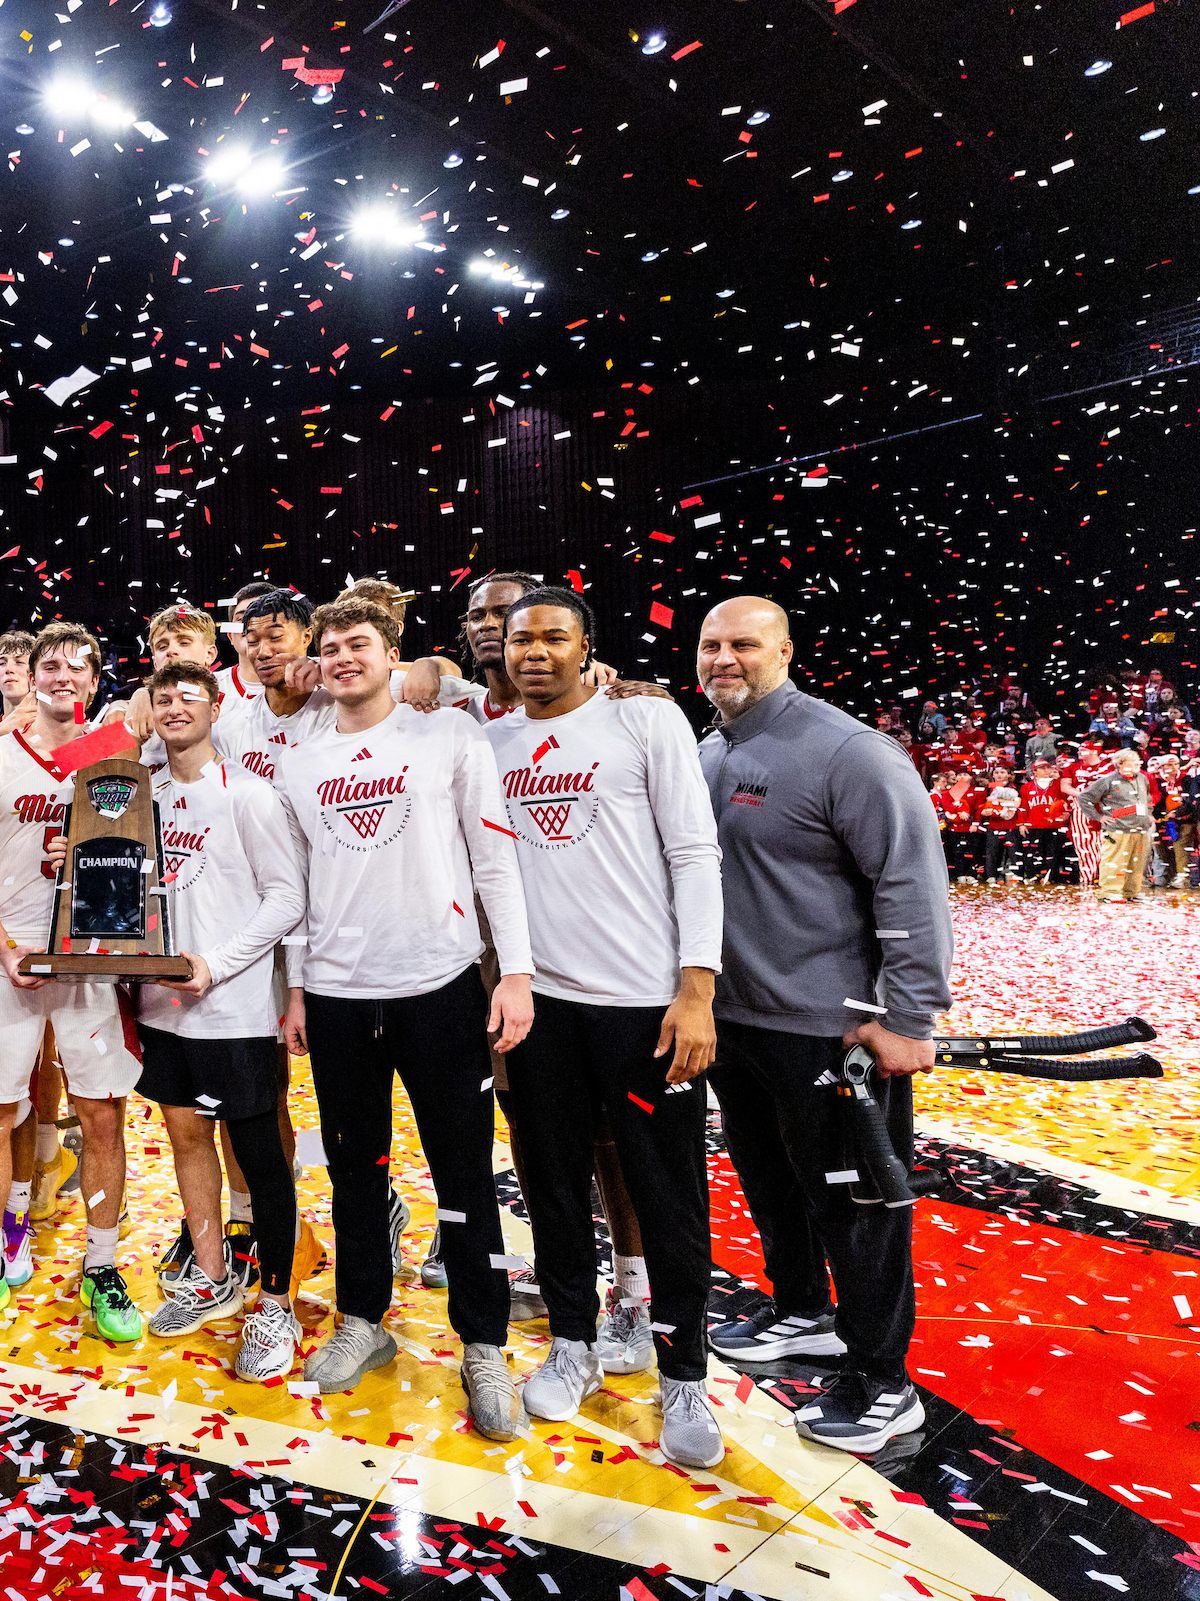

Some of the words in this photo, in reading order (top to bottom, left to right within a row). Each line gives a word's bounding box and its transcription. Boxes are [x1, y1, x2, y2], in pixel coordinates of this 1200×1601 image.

[241, 751, 275, 780] Mia
[502, 761, 600, 799] Miami
[316, 765, 409, 807] Miami
[735, 782, 769, 798] MIAMI
[13, 793, 66, 824] Mia
[729, 796, 765, 808] BASKETBALL
[1027, 794, 1057, 810] MIAM
[162, 820, 211, 852] iami
[320, 811, 335, 834] MIAMI
[382, 797, 412, 846] BASKETBALL
[505, 804, 516, 830] MIAMI
[570, 797, 600, 845] BASKETBALL
[79, 857, 138, 869] CHAMPION
